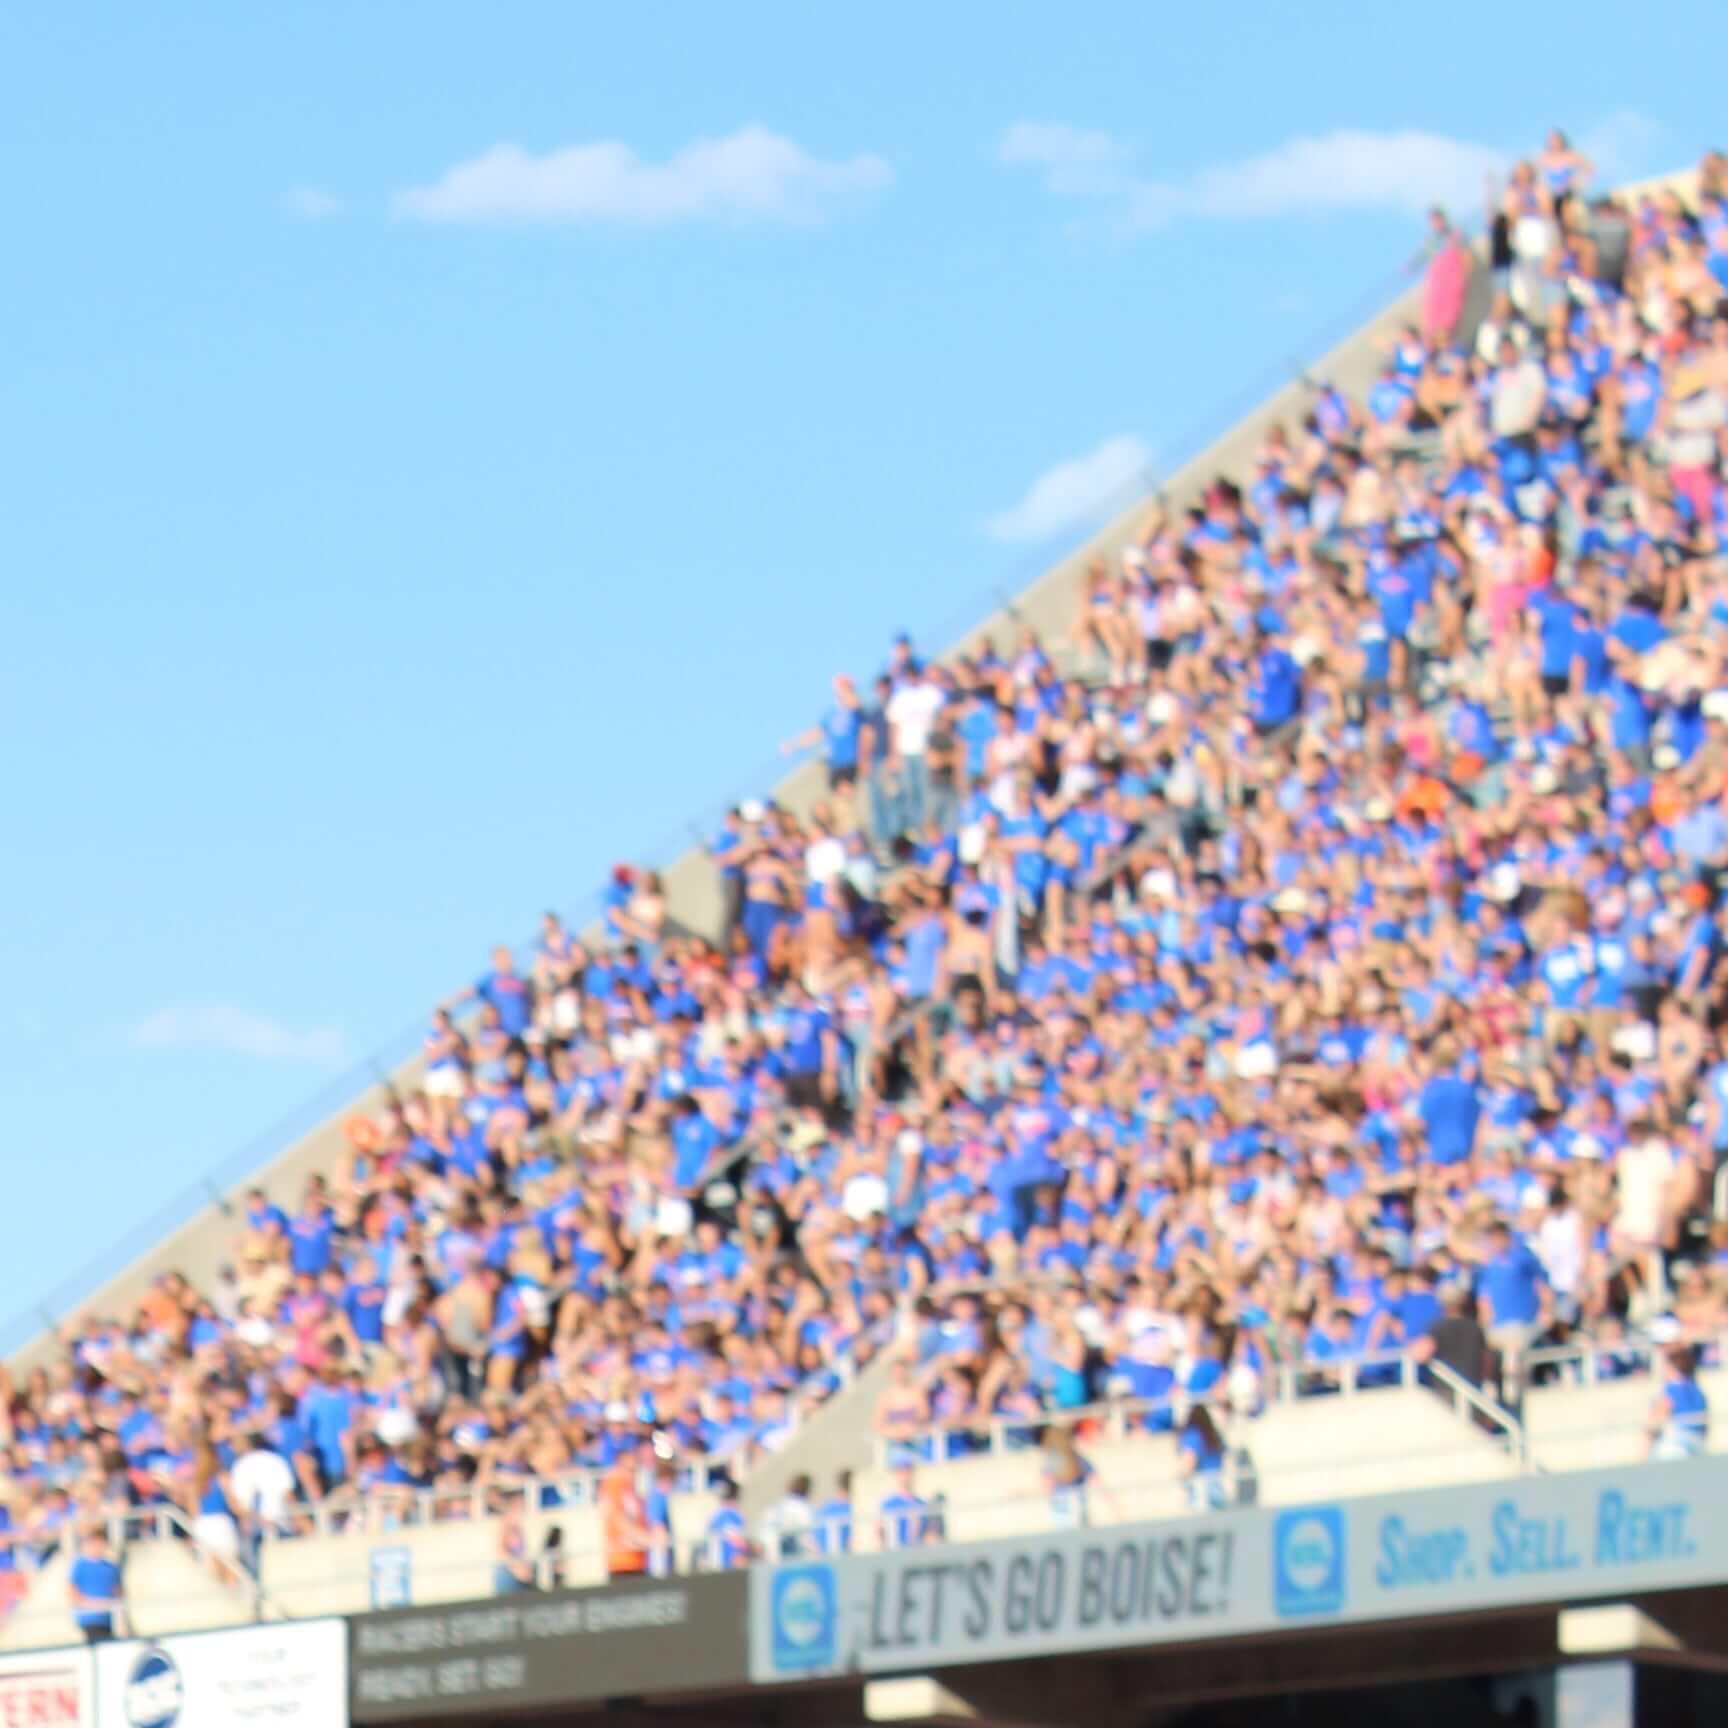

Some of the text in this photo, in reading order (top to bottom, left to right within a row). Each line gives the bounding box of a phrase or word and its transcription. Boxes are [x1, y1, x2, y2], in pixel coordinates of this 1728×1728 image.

[868, 1533, 1236, 1648] LET'S GO BOISE!
